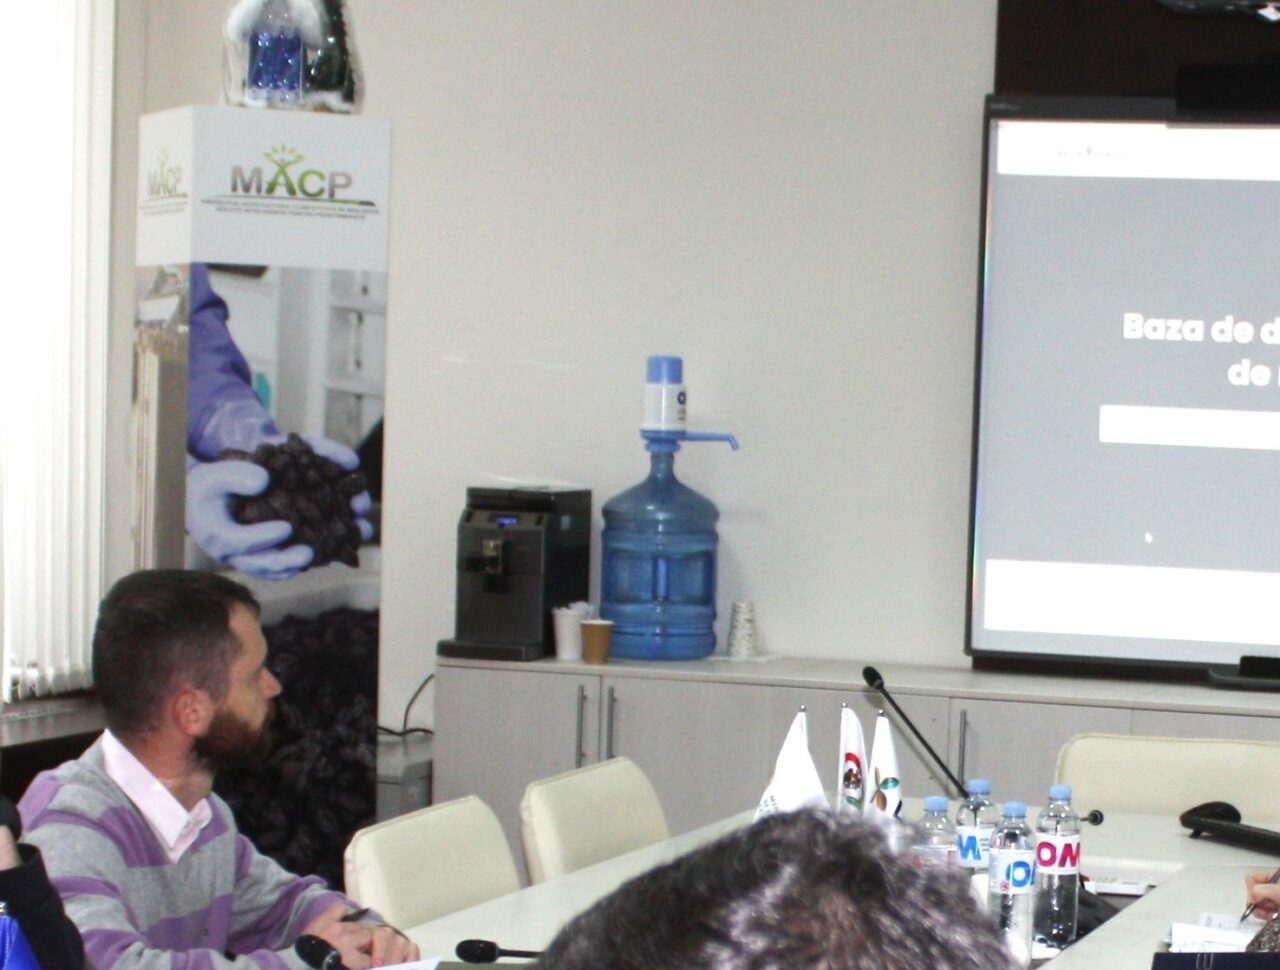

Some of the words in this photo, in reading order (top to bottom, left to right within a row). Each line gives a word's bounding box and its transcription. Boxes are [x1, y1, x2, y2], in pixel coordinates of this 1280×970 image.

[230, 161, 353, 199] MACP
[1124, 313, 1204, 342] Baza
[1210, 315, 1254, 343] de
[1228, 359, 1271, 386] de
